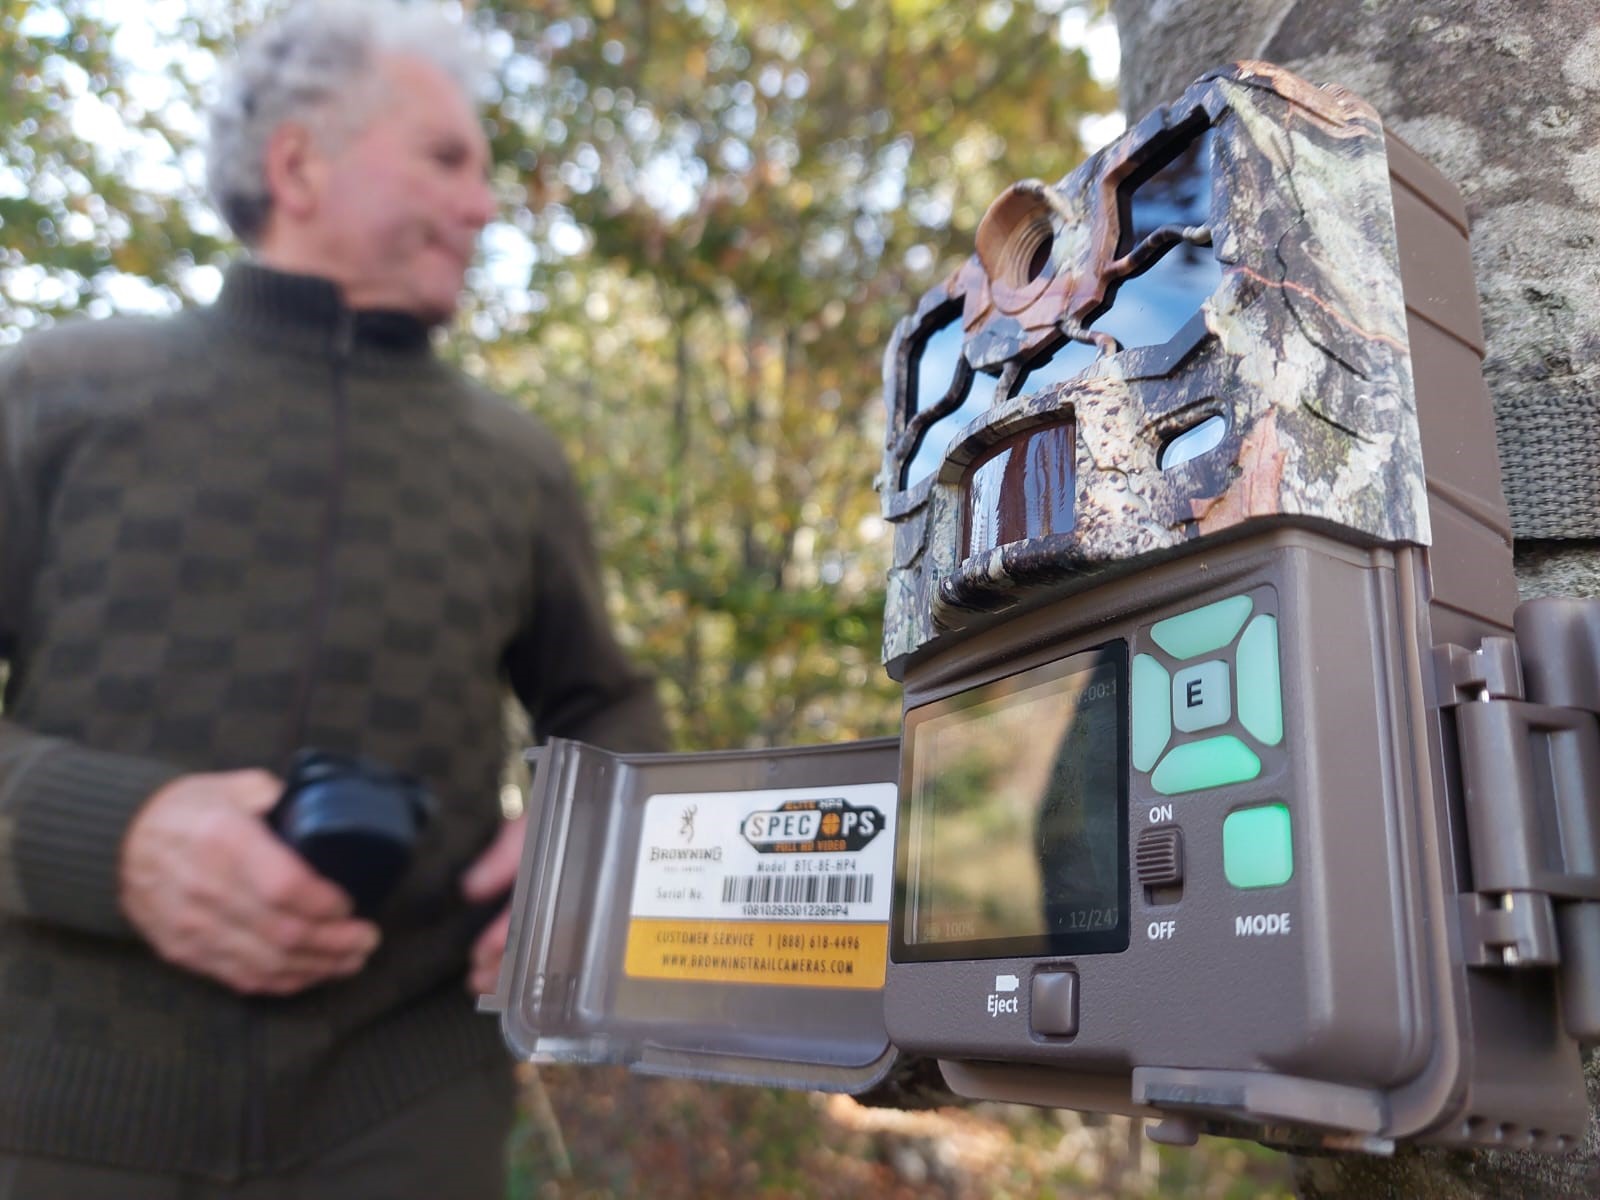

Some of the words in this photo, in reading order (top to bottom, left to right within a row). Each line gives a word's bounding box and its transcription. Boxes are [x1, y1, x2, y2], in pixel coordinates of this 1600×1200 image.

[1187, 678, 1203, 708] E
[1149, 804, 1173, 824] ON
[751, 814, 812, 838] SPEC
[1147, 921, 1176, 940] OFF
[1235, 913, 1291, 937] MODE
[656, 930, 709, 945] CUSTOMER
[713, 932, 755, 947] SERVICE
[987, 994, 1019, 1017] Eject
